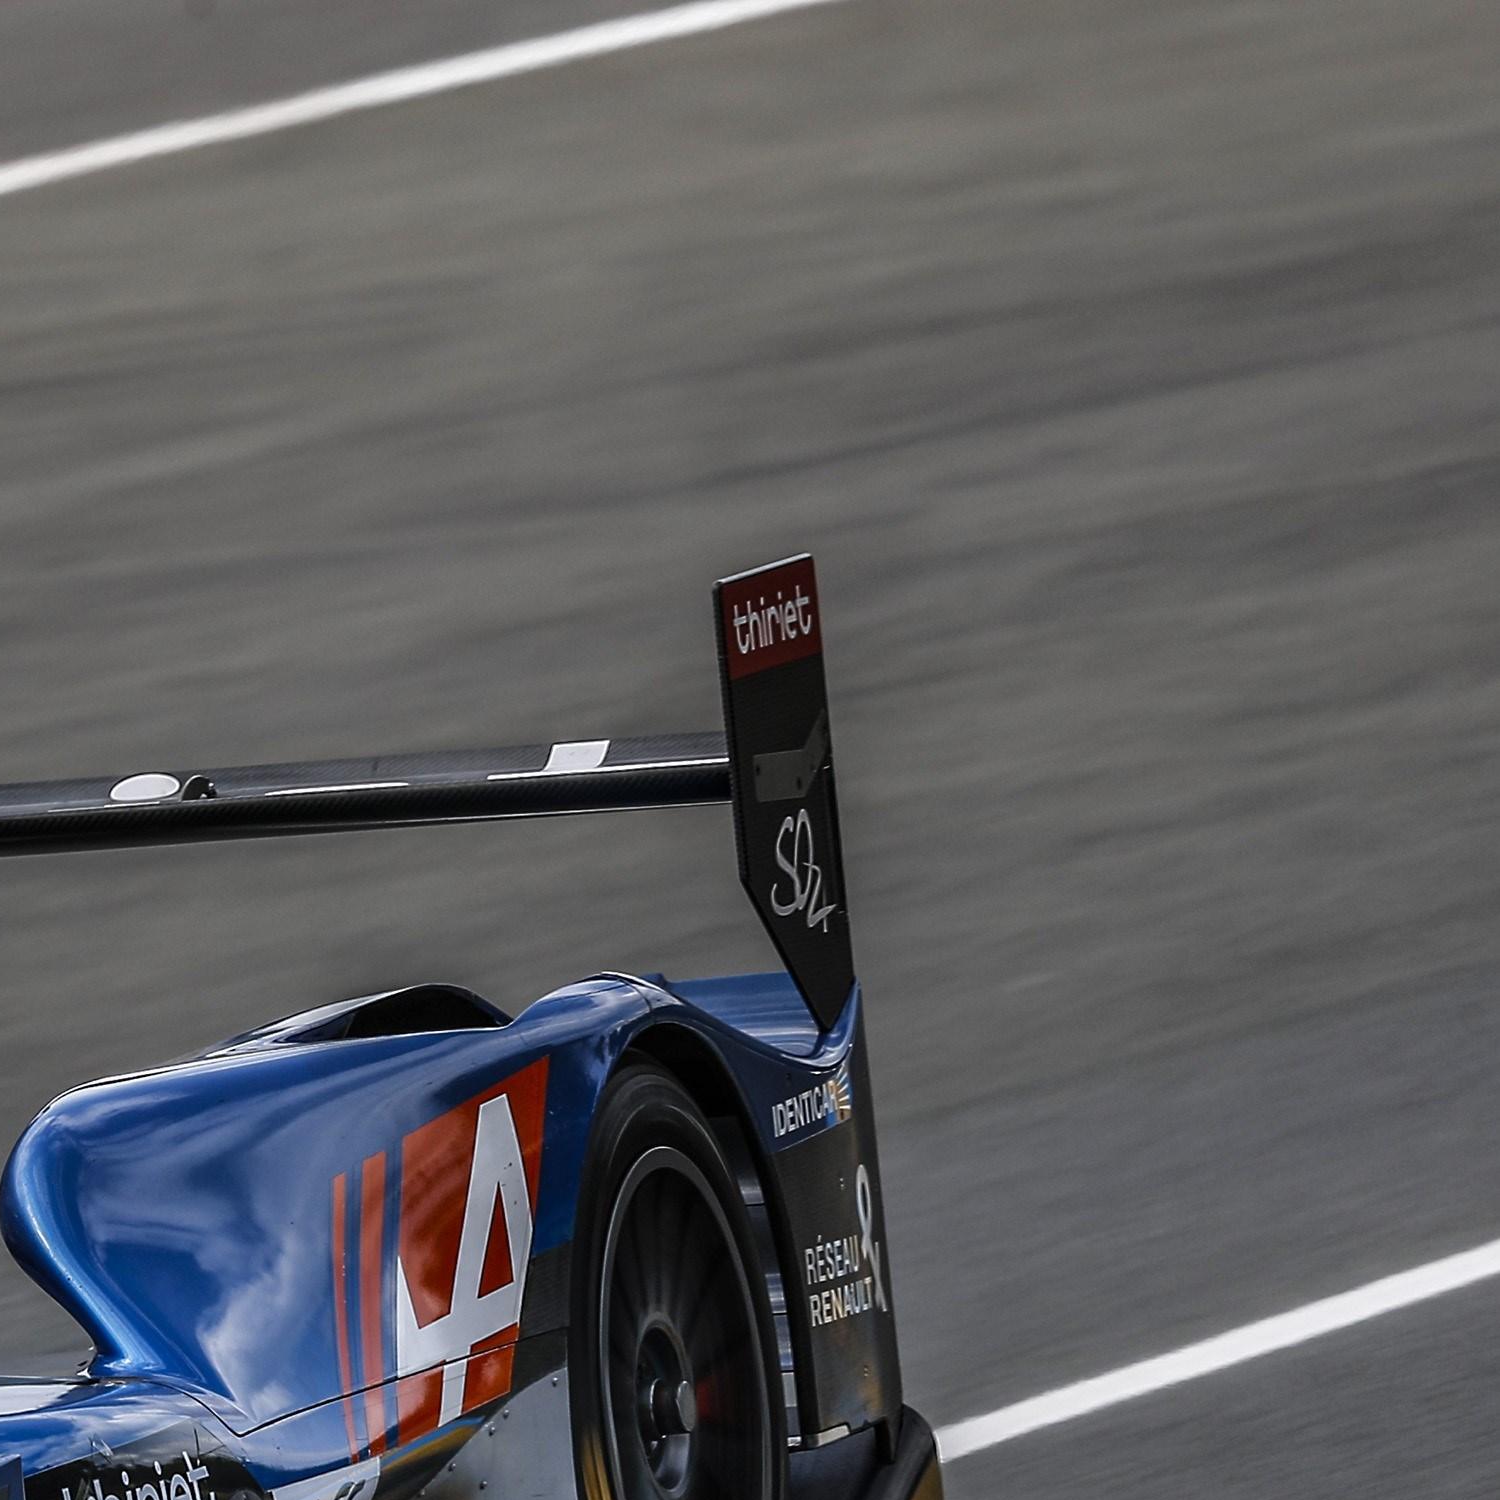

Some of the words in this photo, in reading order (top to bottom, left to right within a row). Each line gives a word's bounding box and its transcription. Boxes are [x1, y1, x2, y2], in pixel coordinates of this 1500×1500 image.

[733, 584, 812, 655] thiriet
[771, 1078, 841, 1139] IDENTICAR
[804, 1233, 862, 1286] RÉSEAU
[809, 1276, 876, 1329] RENAULT
